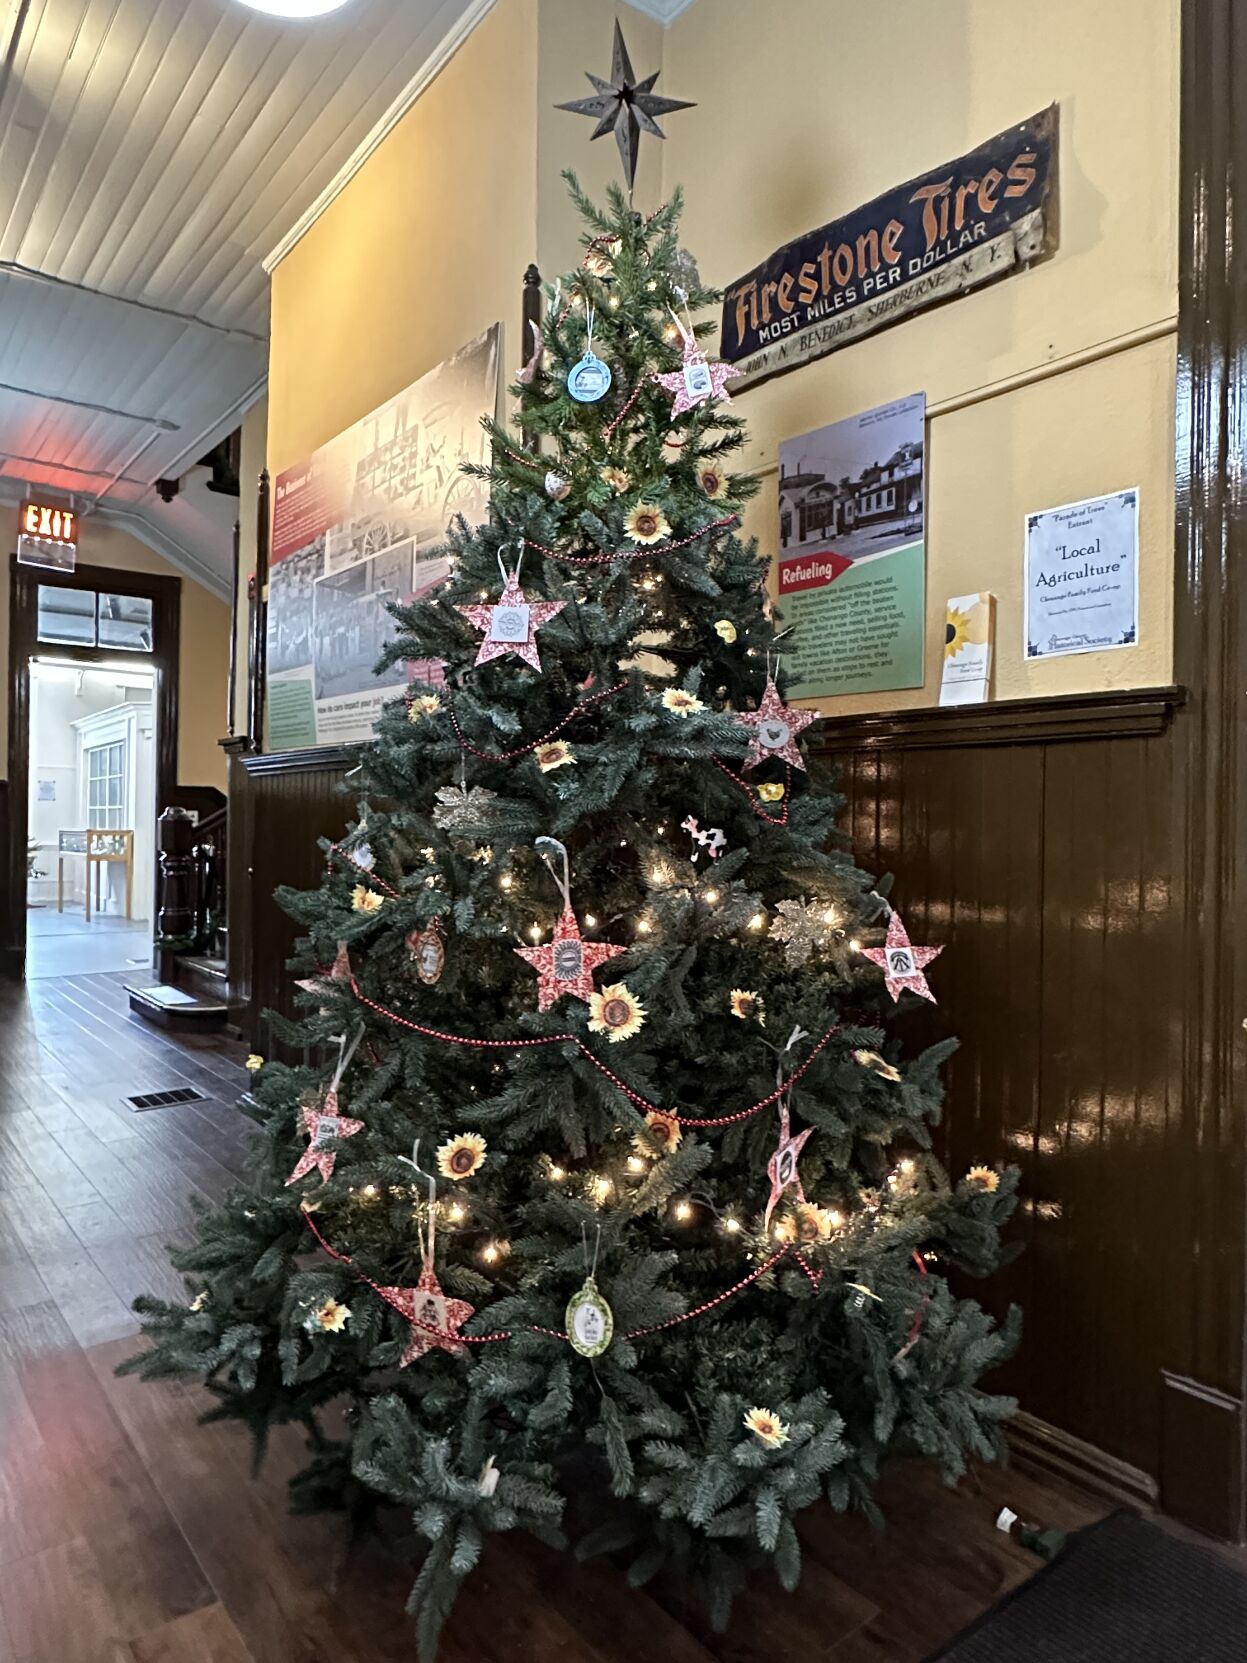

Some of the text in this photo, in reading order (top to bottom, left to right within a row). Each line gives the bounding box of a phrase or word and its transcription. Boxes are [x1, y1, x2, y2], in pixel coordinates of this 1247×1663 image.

[728, 152, 1037, 348] Firestone Tires
[759, 222, 987, 344] MOST MILES PER DOLLAR
[799, 314, 855, 351] BENEDICT
[26, 504, 74, 539] EXIT
[1068, 518, 1092, 528] Entrant
[782, 562, 833, 585] Refueling
